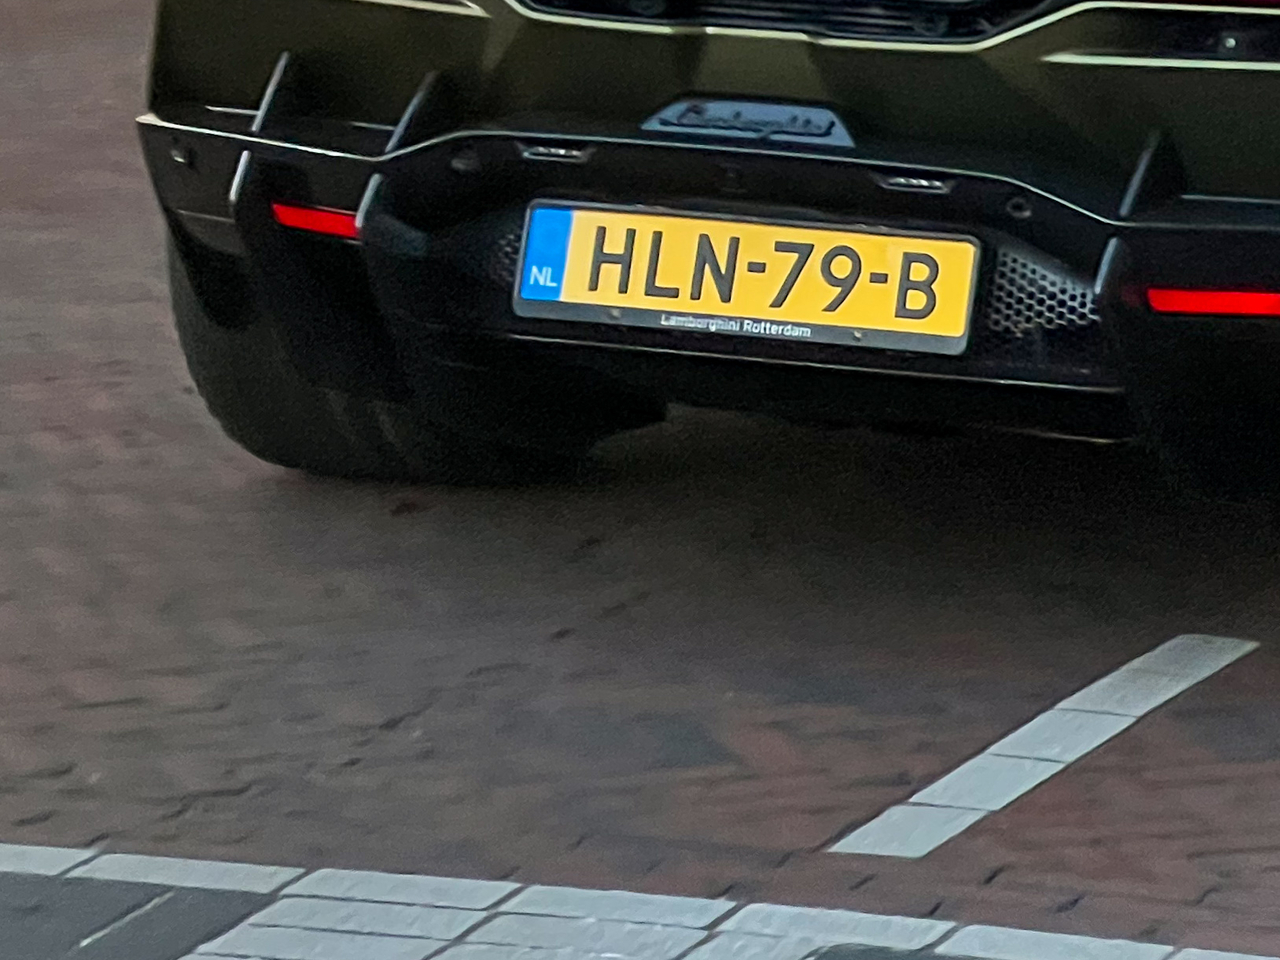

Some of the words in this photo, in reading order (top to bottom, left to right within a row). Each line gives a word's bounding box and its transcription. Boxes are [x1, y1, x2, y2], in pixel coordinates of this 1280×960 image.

[530, 265, 558, 287] NL
[587, 225, 940, 320] HLN-79-B
[660, 314, 740, 332] Lamborghini
[743, 319, 812, 338] Rotterdam
